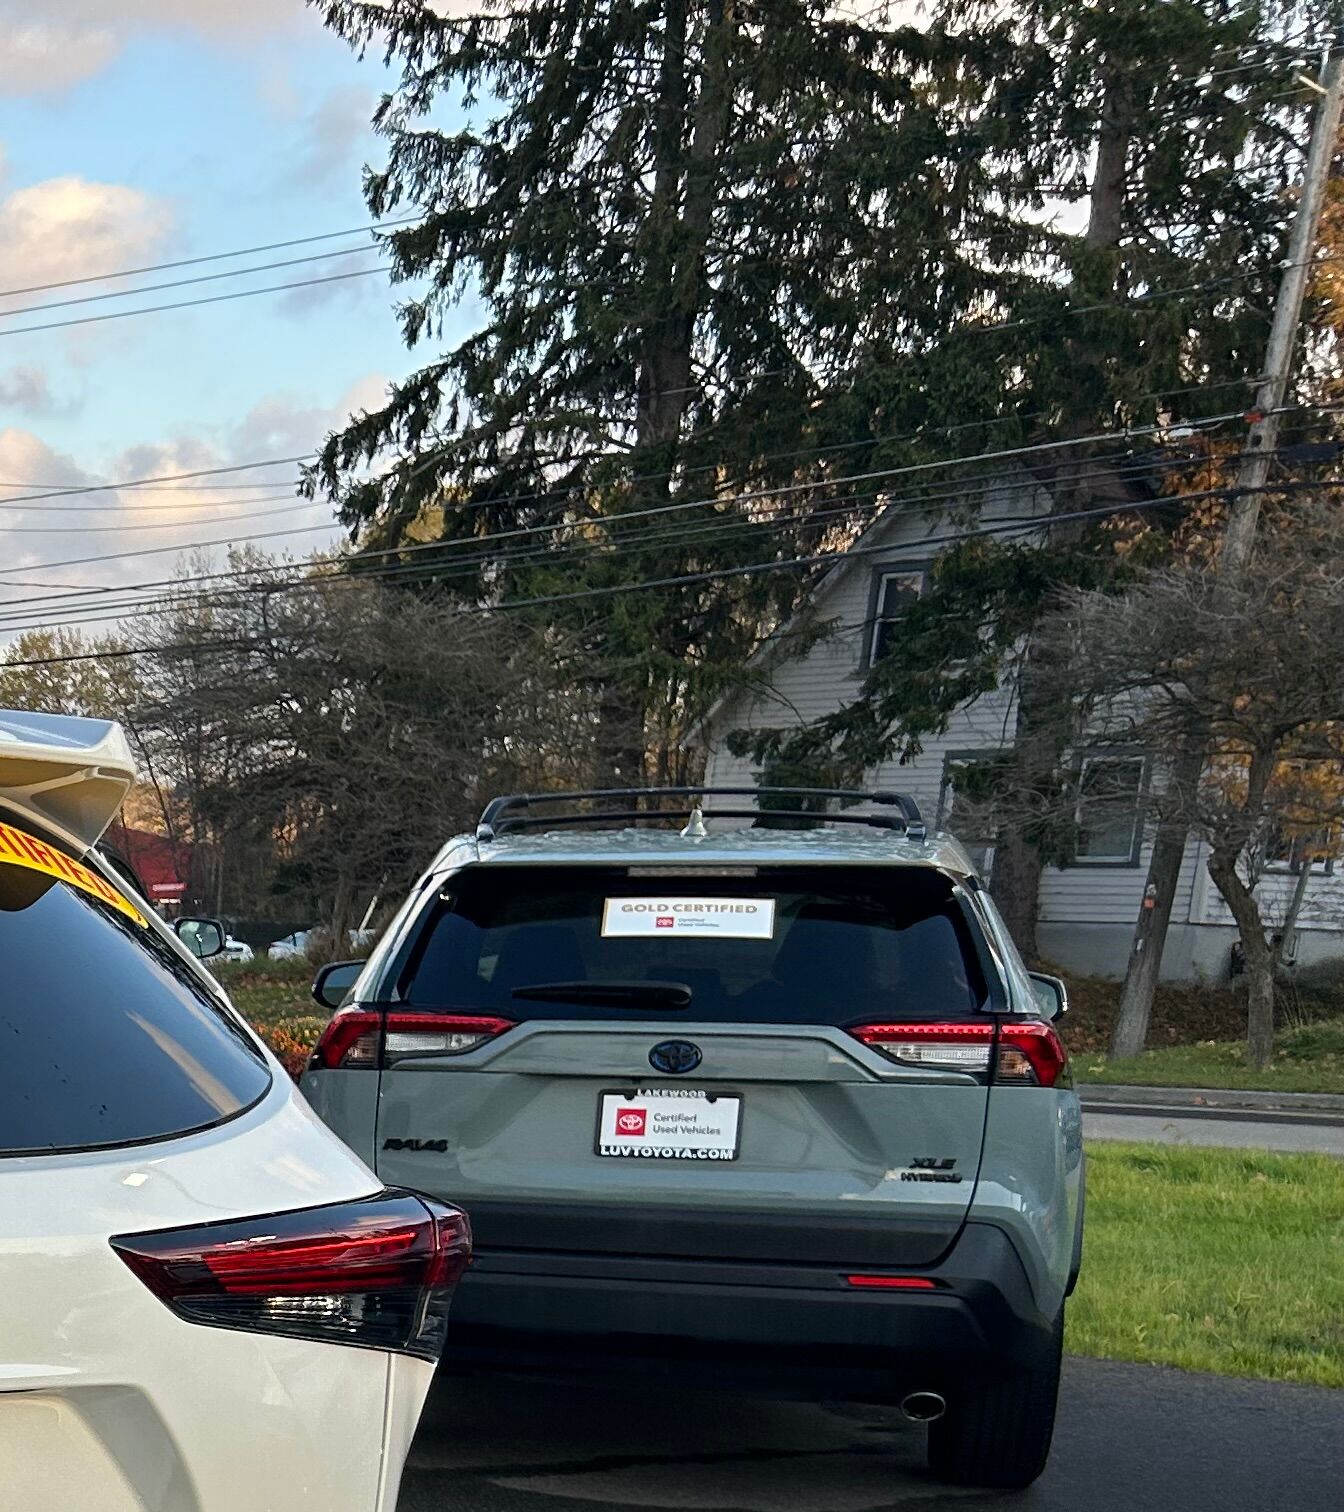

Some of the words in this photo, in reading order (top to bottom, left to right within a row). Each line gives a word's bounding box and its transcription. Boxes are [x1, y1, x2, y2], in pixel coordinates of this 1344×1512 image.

[621, 903, 669, 913] GOLD
[672, 903, 758, 914] CERTIFIED
[637, 1089, 707, 1098] LAKEWOOD
[653, 1113, 697, 1123] Certified
[652, 1125, 678, 1135] Used
[680, 1125, 721, 1136] Vehicles
[600, 1146, 734, 1160] LUVTOYOTA.COM
[909, 1157, 957, 1169] XLE
